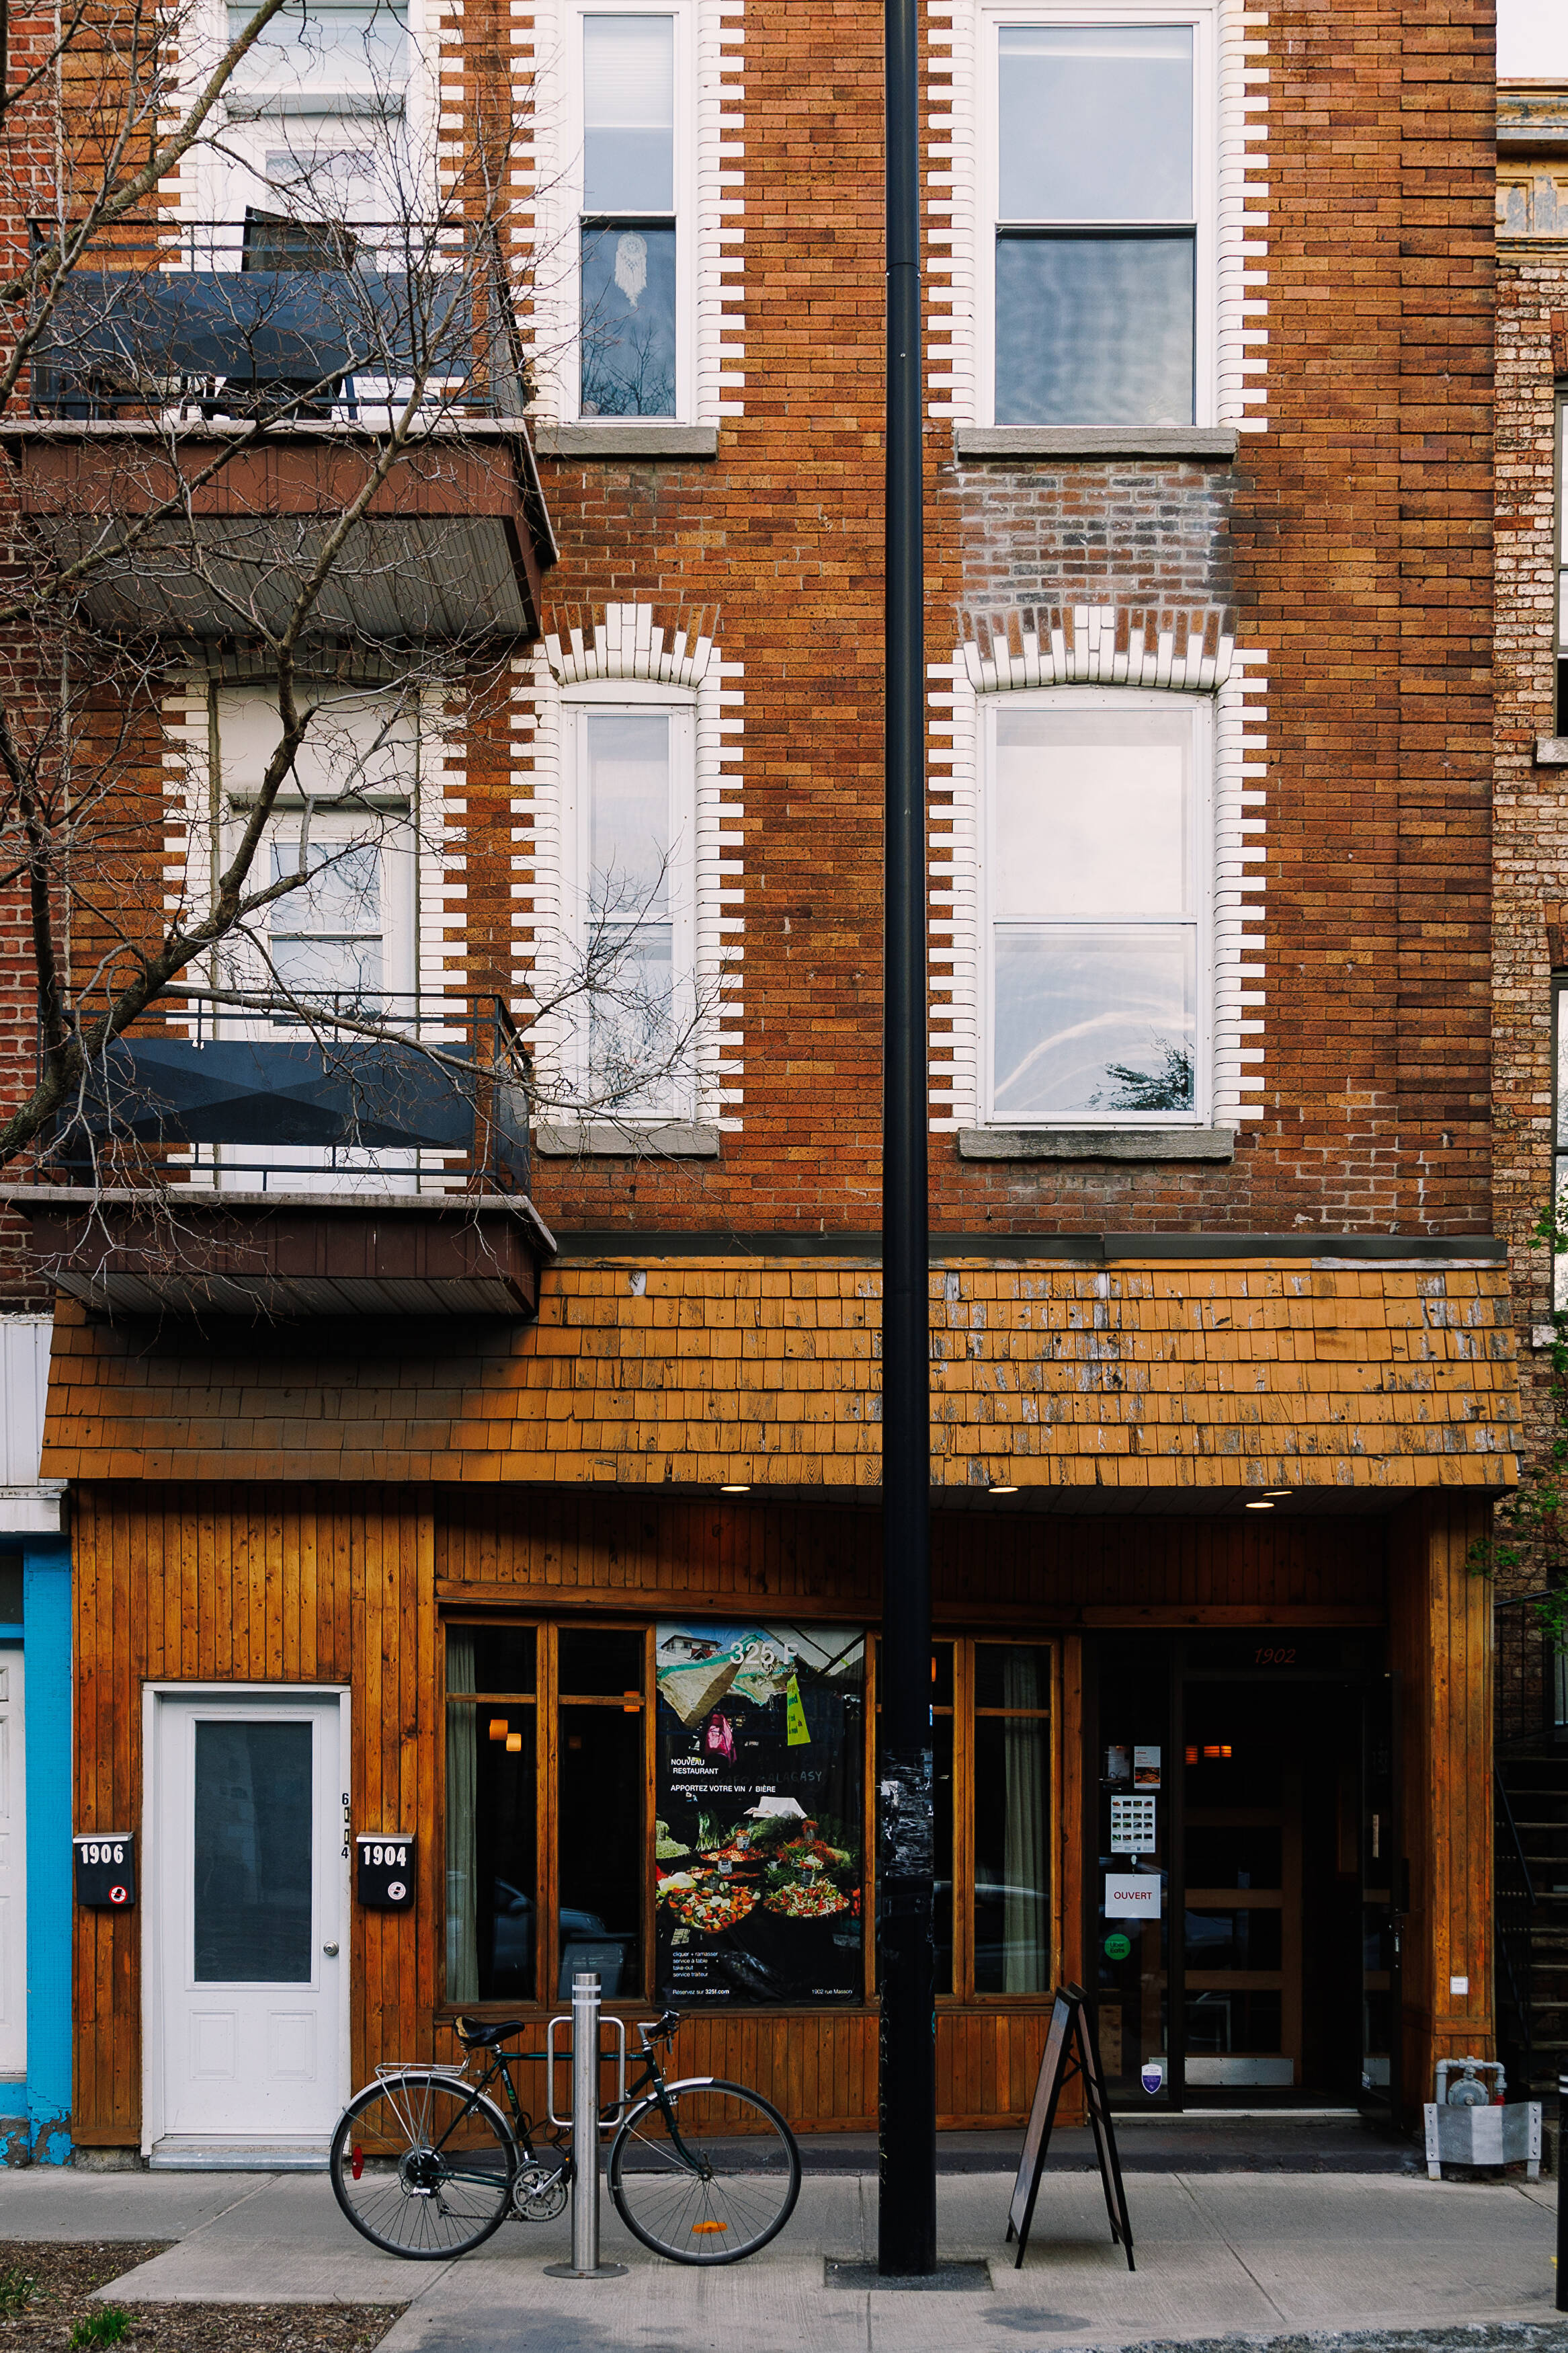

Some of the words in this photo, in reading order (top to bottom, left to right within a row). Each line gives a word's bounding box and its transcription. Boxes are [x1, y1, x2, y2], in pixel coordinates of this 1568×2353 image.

[730, 1642, 775, 1665] 325
[784, 1642, 798, 1665] F
[1255, 1648, 1296, 1664] 1902
[755, 1784, 776, 1792] BIÈRE
[342, 1793, 349, 1805] 6
[81, 1844, 124, 1864] 1906
[341, 1847, 349, 1859] 4
[364, 1845, 407, 1866] 1904
[1114, 1891, 1153, 1900] OUVERT
